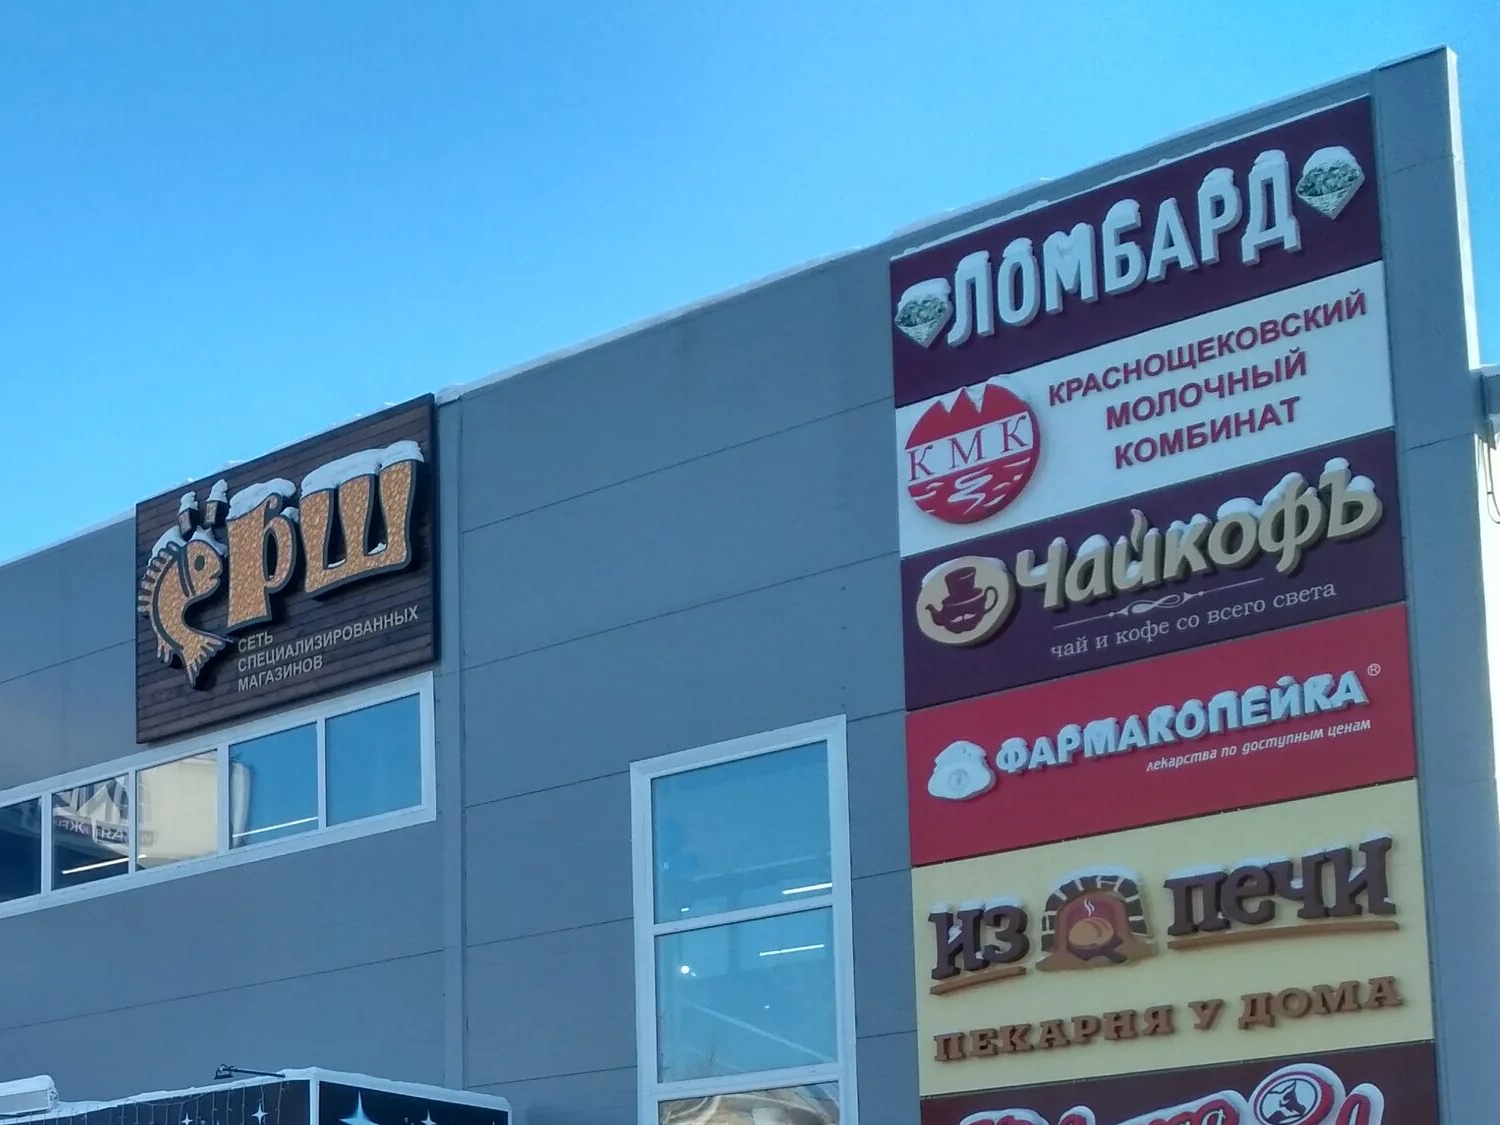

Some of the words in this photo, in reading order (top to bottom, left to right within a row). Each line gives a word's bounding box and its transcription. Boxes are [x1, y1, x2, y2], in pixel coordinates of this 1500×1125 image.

[948, 149, 1301, 347] ЛОМБАРД
[1047, 289, 1367, 408] КРАСНОЩЕКОВСКИЙ
[1105, 349, 1308, 431] МОЛОЧНЫЙ
[1115, 395, 1301, 470] КОМБИНАТ
[238, 605, 419, 673] СПЕЦИАЛИЗИРОВАННЫХ
[238, 631, 273, 653] СЕТЬ
[1051, 635, 1089, 659] чай
[1095, 632, 1109, 650] и
[1115, 620, 1171, 652] кофе
[1176, 614, 1200, 631] со
[1206, 597, 1266, 627] всего
[1273, 582, 1337, 611] света
[238, 655, 324, 692] МАГАЗИНОВ
[995, 670, 1369, 775] ФАРМАКОПЕЙКА
[1146, 747, 1218, 773] лекарства
[1220, 745, 1237, 760] по
[1242, 728, 1324, 756] доступным
[1327, 718, 1371, 739] ценам
[933, 1005, 1176, 1063] ПЕКАРНЯ
[1187, 999, 1225, 1031] У
[1238, 976, 1404, 1030] ДОМА
